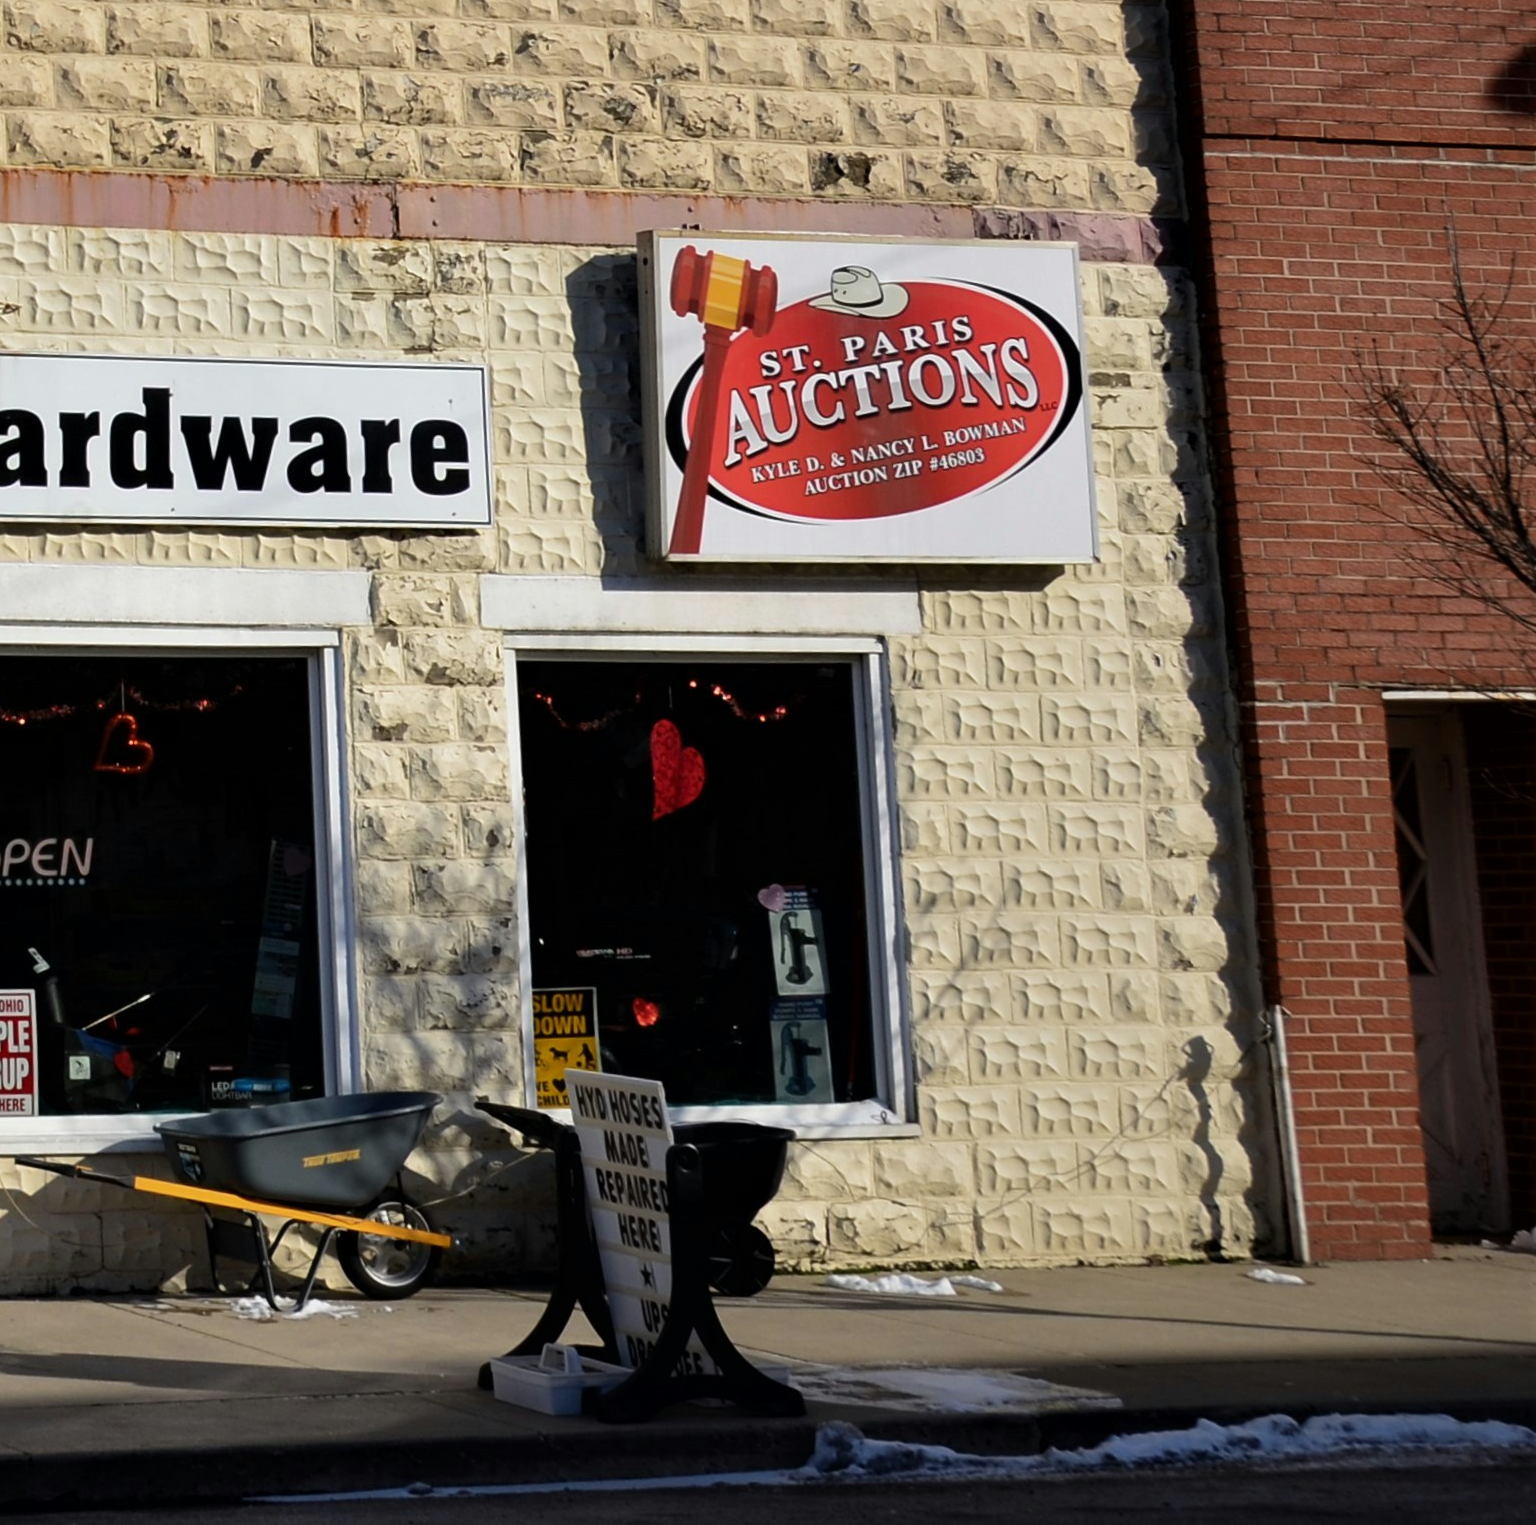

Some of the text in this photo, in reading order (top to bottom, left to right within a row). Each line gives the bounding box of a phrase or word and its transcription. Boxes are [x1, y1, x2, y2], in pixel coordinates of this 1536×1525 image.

[759, 315, 973, 377] ST. PARIS
[724, 338, 1040, 467] AUCTIONS
[1039, 401, 1058, 412] LLC
[750, 416, 1027, 483] KYLE D. & NANCY L. BOWMAN
[804, 447, 986, 496] AUCTION ZIP #46803
[532, 993, 584, 1013] SLOW
[575, 1084, 664, 1130] HYD HOSES
[604, 1129, 650, 1169] MADE
[595, 1167, 670, 1214] REPAIRED
[617, 1212, 661, 1254] HERE
